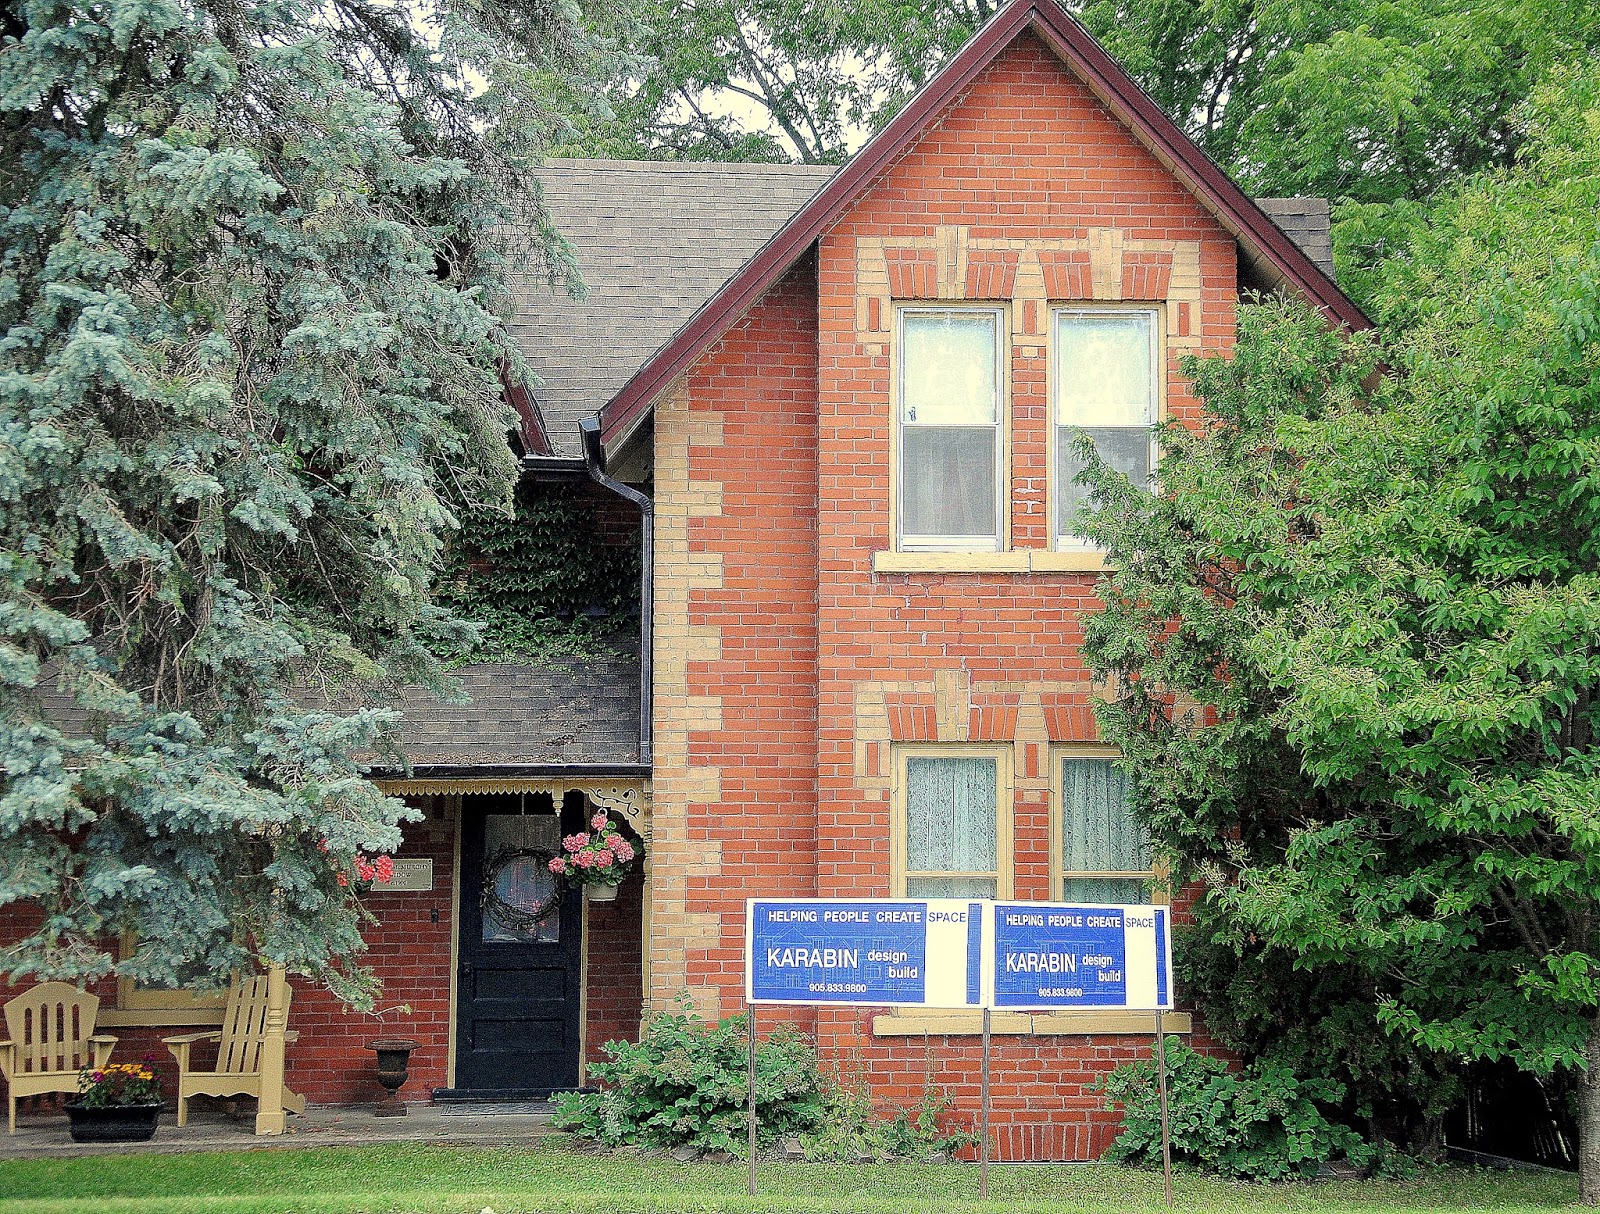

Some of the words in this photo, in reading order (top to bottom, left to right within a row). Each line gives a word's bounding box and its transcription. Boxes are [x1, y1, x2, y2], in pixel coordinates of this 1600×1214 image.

[768, 910, 818, 922] HELPING
[824, 911, 869, 923] PEOPLE
[876, 911, 922, 923] CREATE
[928, 912, 967, 923] SPACE
[1006, 914, 1044, 926] HELPING
[1048, 915, 1082, 927] PEOPLE
[1087, 916, 1121, 928] CREATE
[1125, 917, 1154, 928] SPACE
[767, 948, 858, 969] KARABIN
[867, 949, 908, 964] design
[1006, 952, 1076, 973] KARABIN
[1082, 954, 1113, 968] design
[888, 966, 918, 979] build
[1098, 970, 1121, 982] build
[809, 983, 867, 993] 905.833.9800
